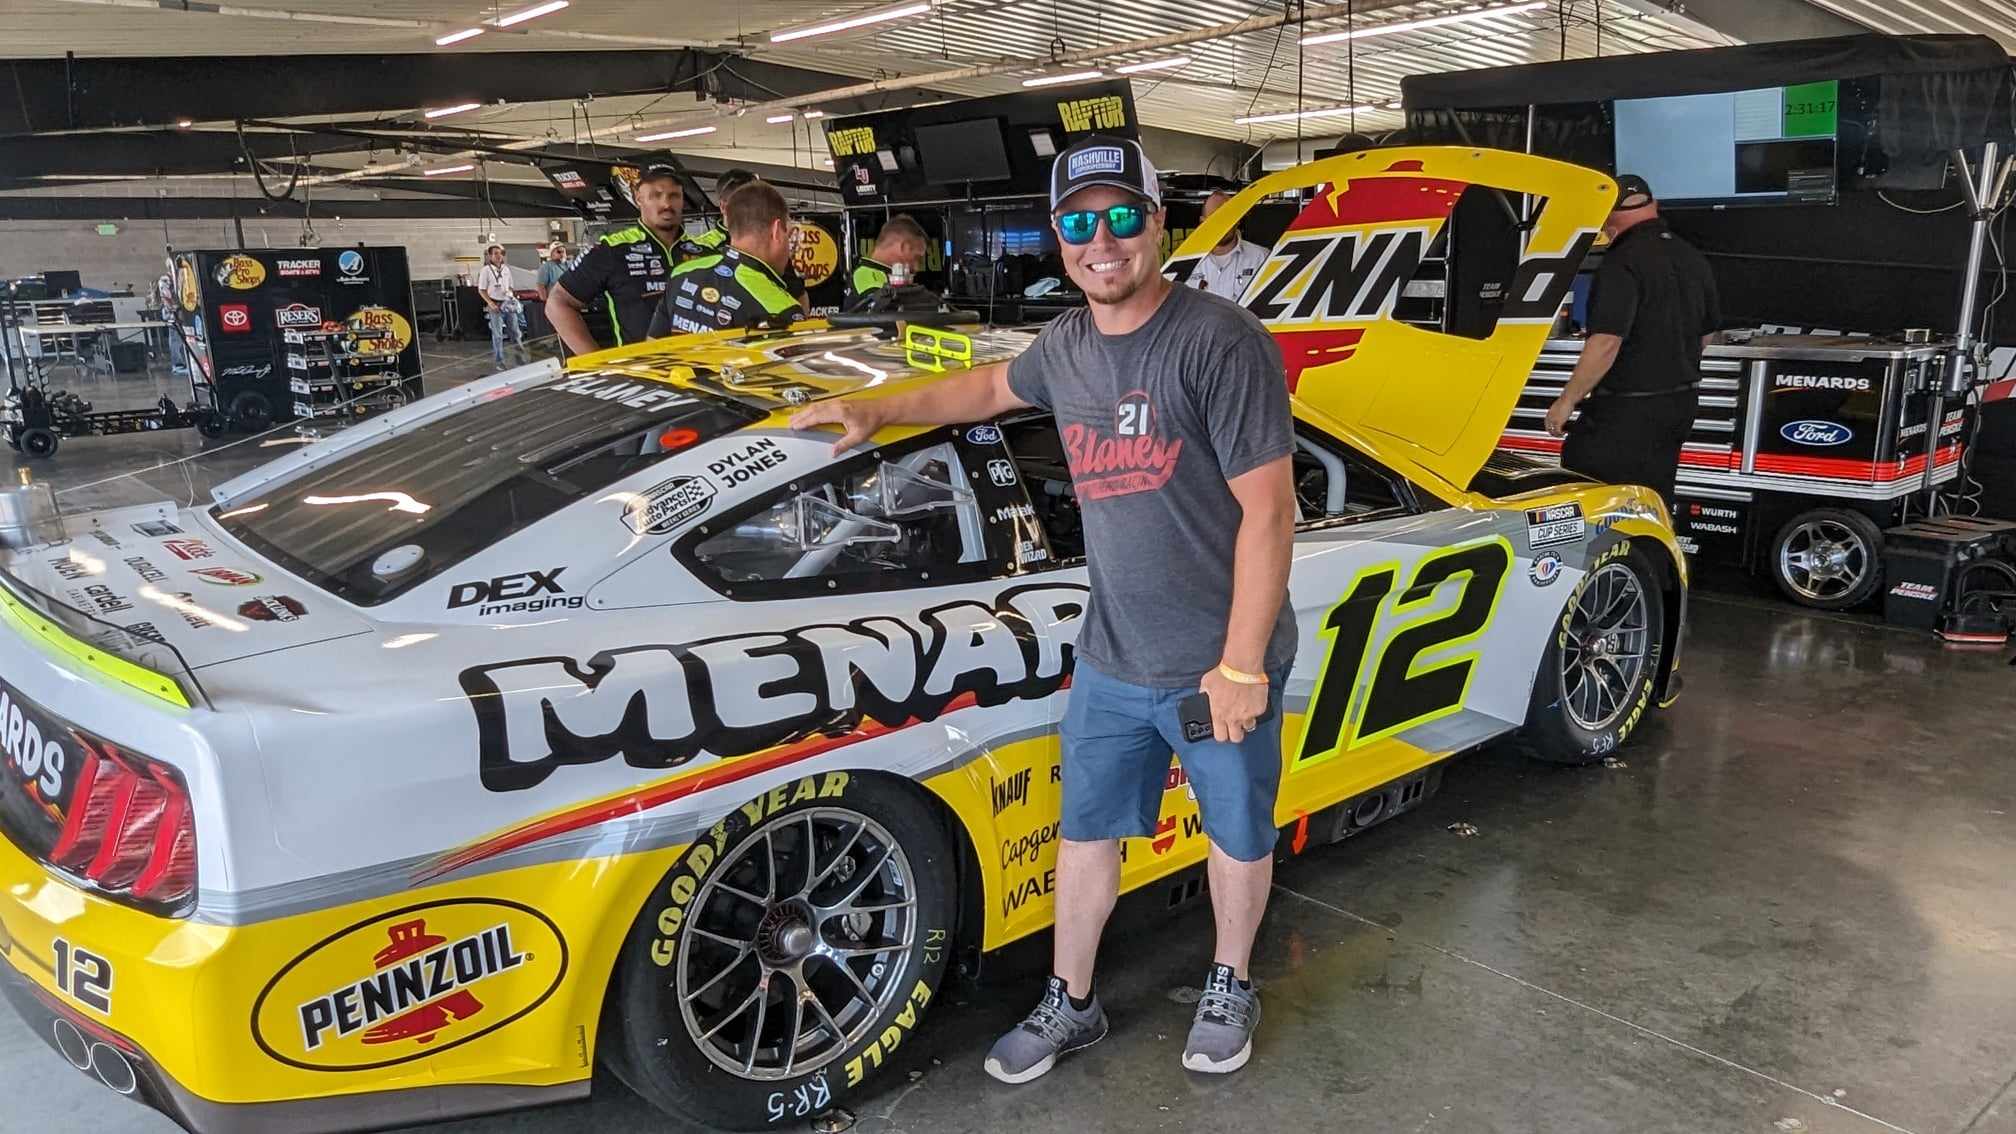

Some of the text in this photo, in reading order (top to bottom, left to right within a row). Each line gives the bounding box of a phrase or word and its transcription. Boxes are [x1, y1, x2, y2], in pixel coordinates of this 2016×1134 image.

[1057, 96, 1126, 132] RAPTOR
[1785, 101, 1836, 116] 2:31:17
[827, 127, 876, 156] RAPTOR
[1071, 150, 1121, 170] NASHVILLE
[276, 259, 321, 270] TRACKER
[794, 259, 830, 280] Shops
[364, 311, 393, 325] Bass
[1775, 374, 1871, 390] MENARDS
[1118, 403, 1149, 435] 21
[1792, 423, 1840, 443] Ford
[707, 437, 776, 476] DYLAN
[1063, 422, 1184, 477] Blaney
[720, 449, 788, 490] JONES
[1546, 506, 1575, 521] NASCAR
[1690, 521, 1737, 534] WABASH
[1537, 522, 1579, 538] CUP SERIES
[446, 567, 568, 609] DEX
[479, 594, 584, 616] imaging
[1291, 535, 1515, 773] 12
[991, 767, 1032, 819] KNAUF
[922, 928, 946, 967] R12
[53, 936, 112, 1016] 12
[298, 921, 527, 1052] PENNZOIL
[844, 979, 933, 1089] EAGLE
